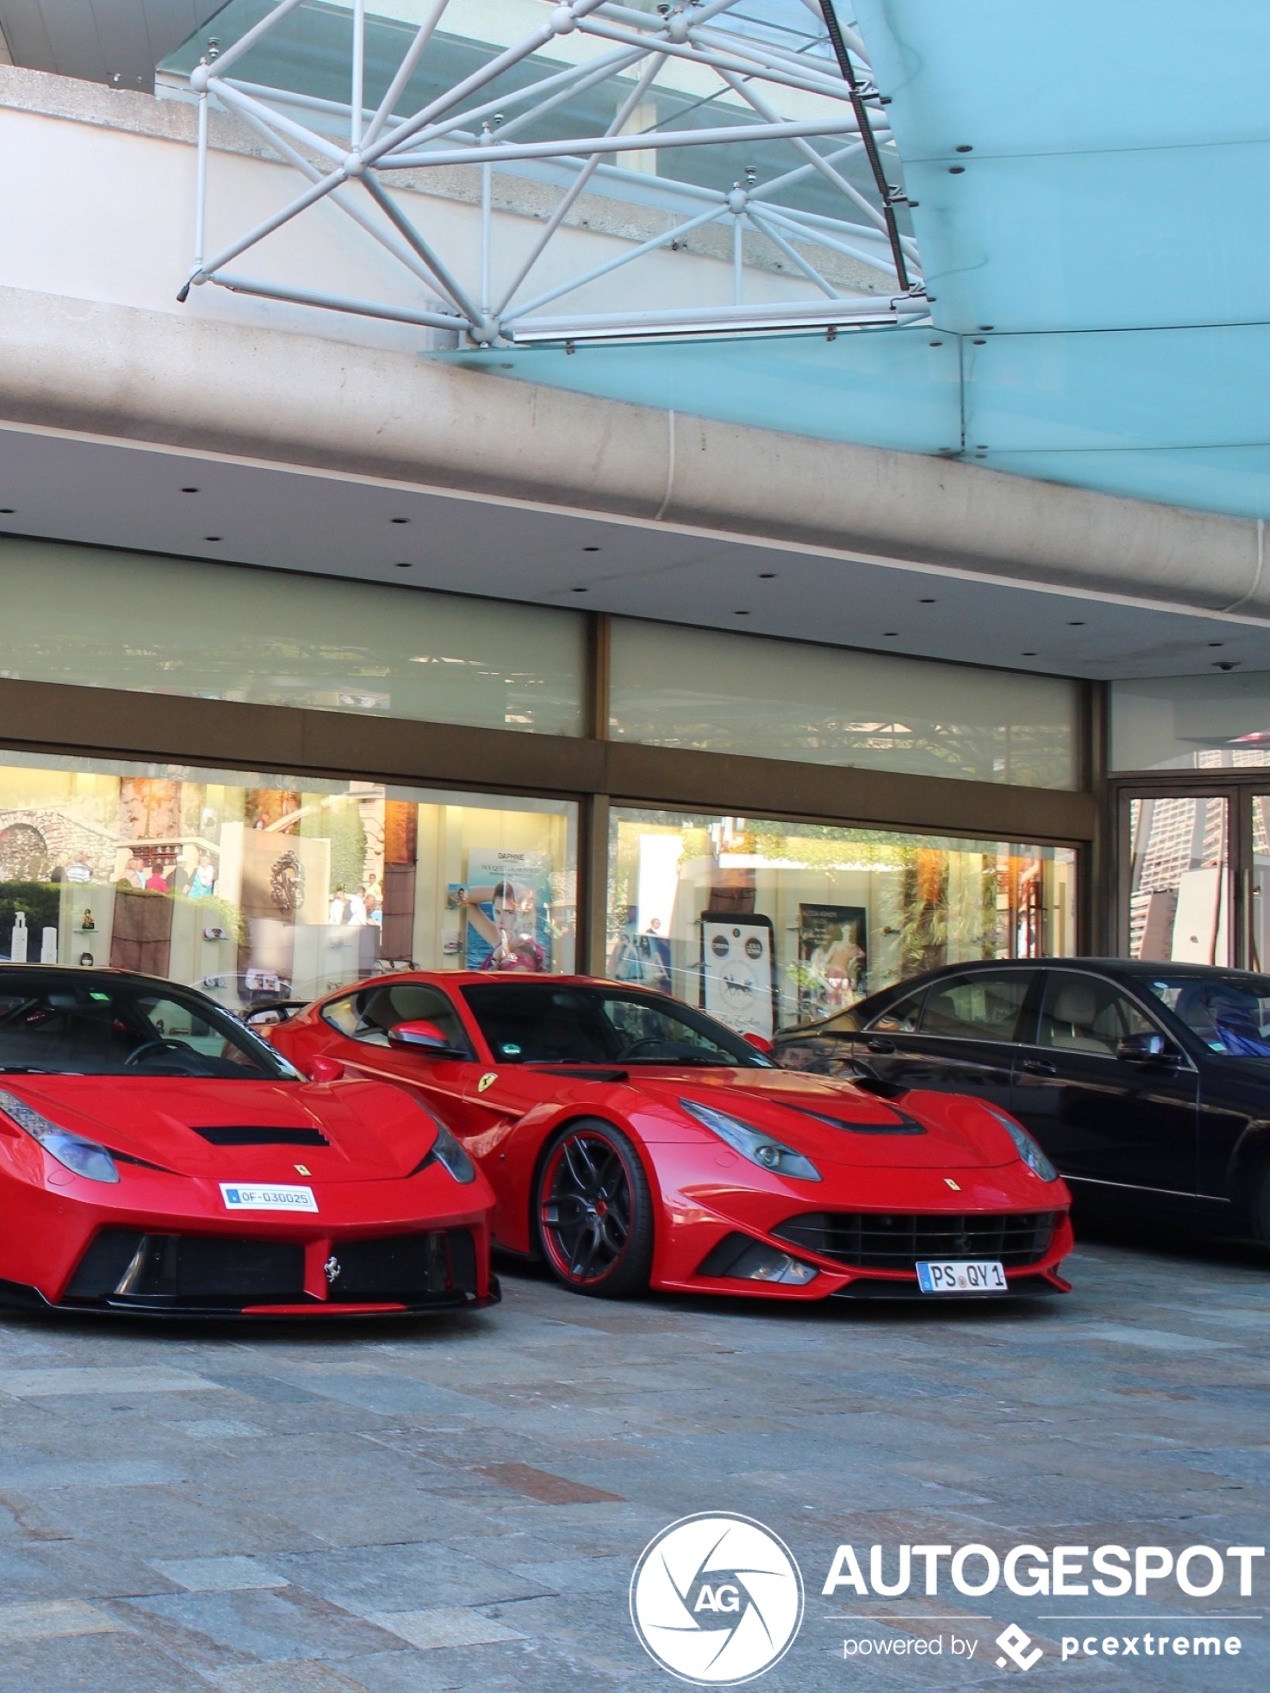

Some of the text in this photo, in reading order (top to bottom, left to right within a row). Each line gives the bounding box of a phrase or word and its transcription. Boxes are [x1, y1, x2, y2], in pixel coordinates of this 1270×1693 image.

[498, 852, 525, 861] DAPHNE
[930, 1265, 956, 1288] PS
[966, 1265, 988, 1287] QY
[992, 1265, 1004, 1286] 1
